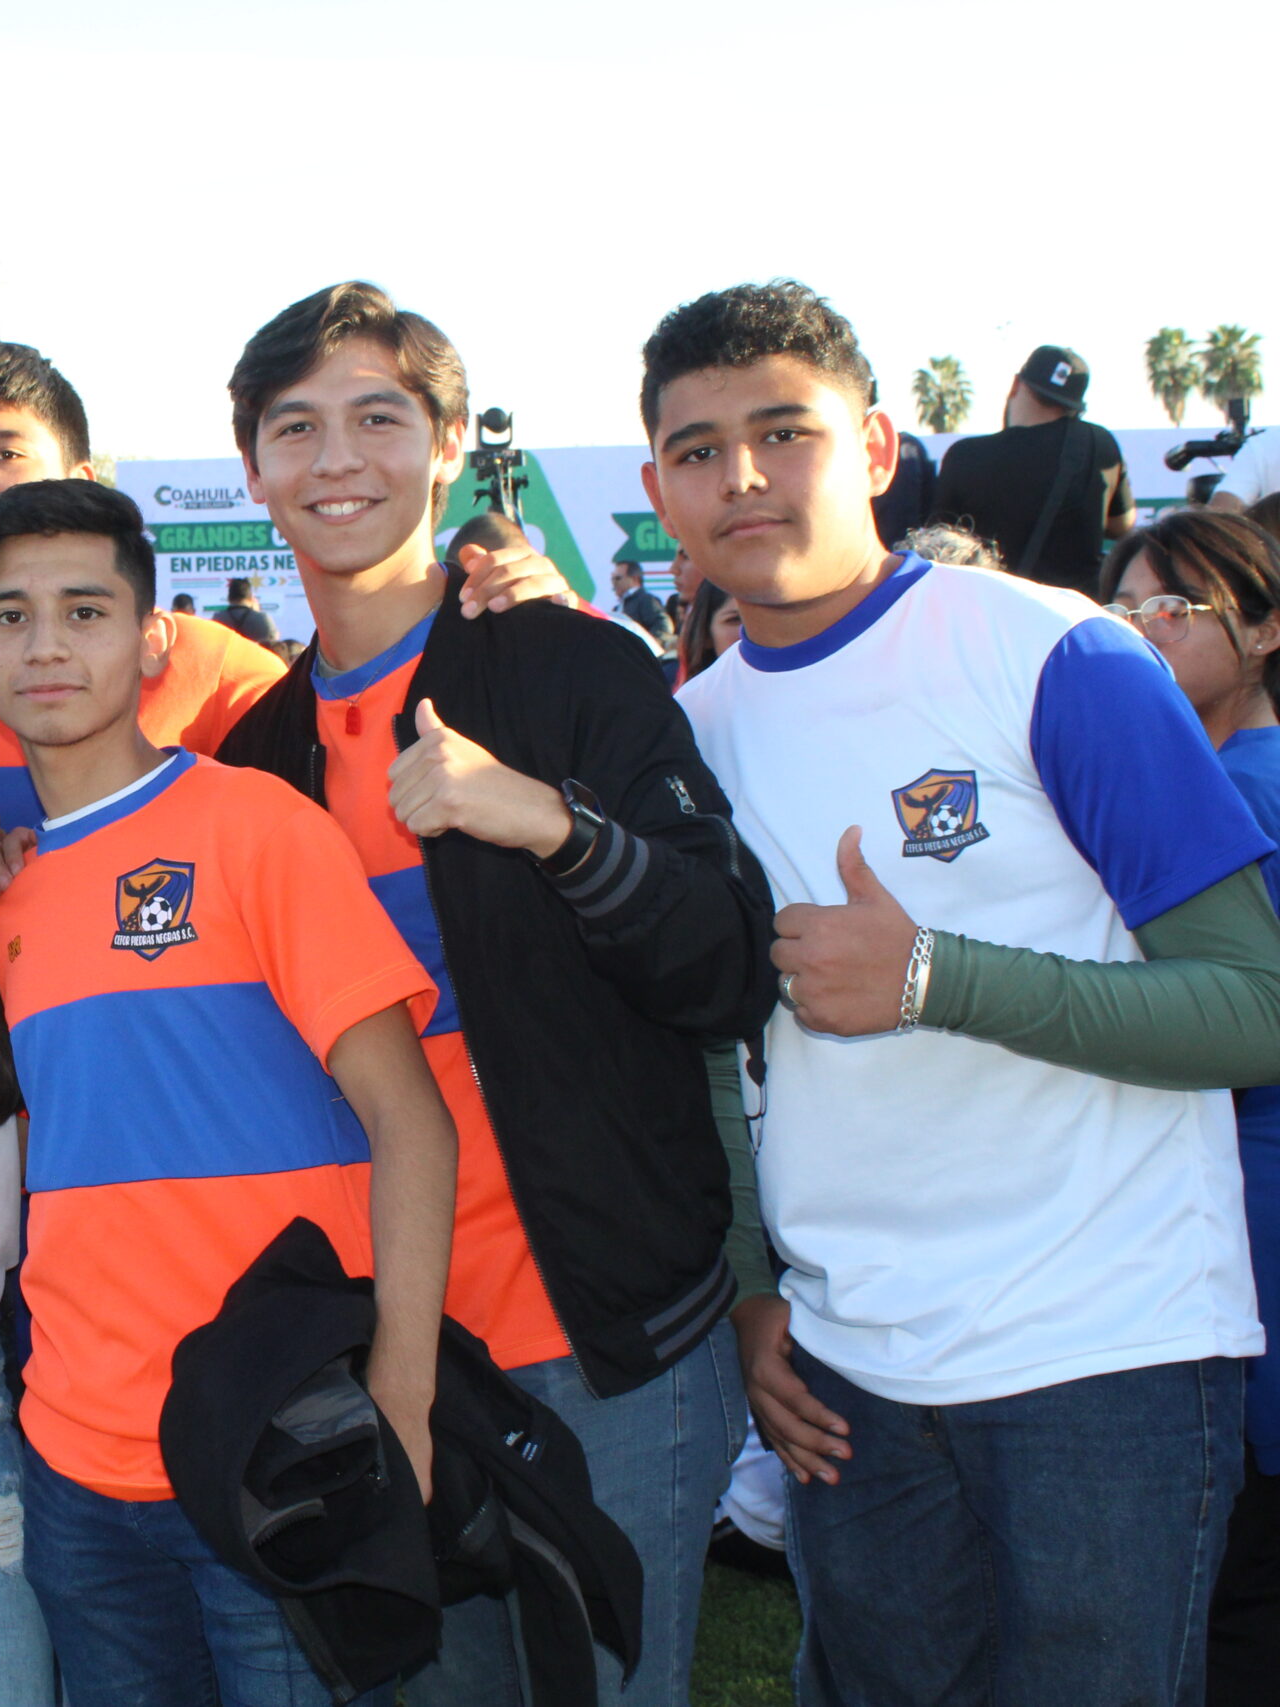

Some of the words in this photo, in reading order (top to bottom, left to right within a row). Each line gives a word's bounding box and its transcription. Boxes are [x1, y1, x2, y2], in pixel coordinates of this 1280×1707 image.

[154, 485, 245, 506] COAHUILA
[160, 525, 267, 549] GRANDES
[170, 557, 192, 573] EN
[196, 554, 269, 572] PIEDRAS
[273, 554, 296, 571] NE
[924, 839, 950, 852] PIEDRAS
[950, 831, 975, 846] NEGRAS
[114, 934, 130, 946] CEFOR
[130, 934, 155, 946] PIEDRAS
[155, 930, 181, 945] NEGRAS
[181, 926, 195, 940] S.C.
